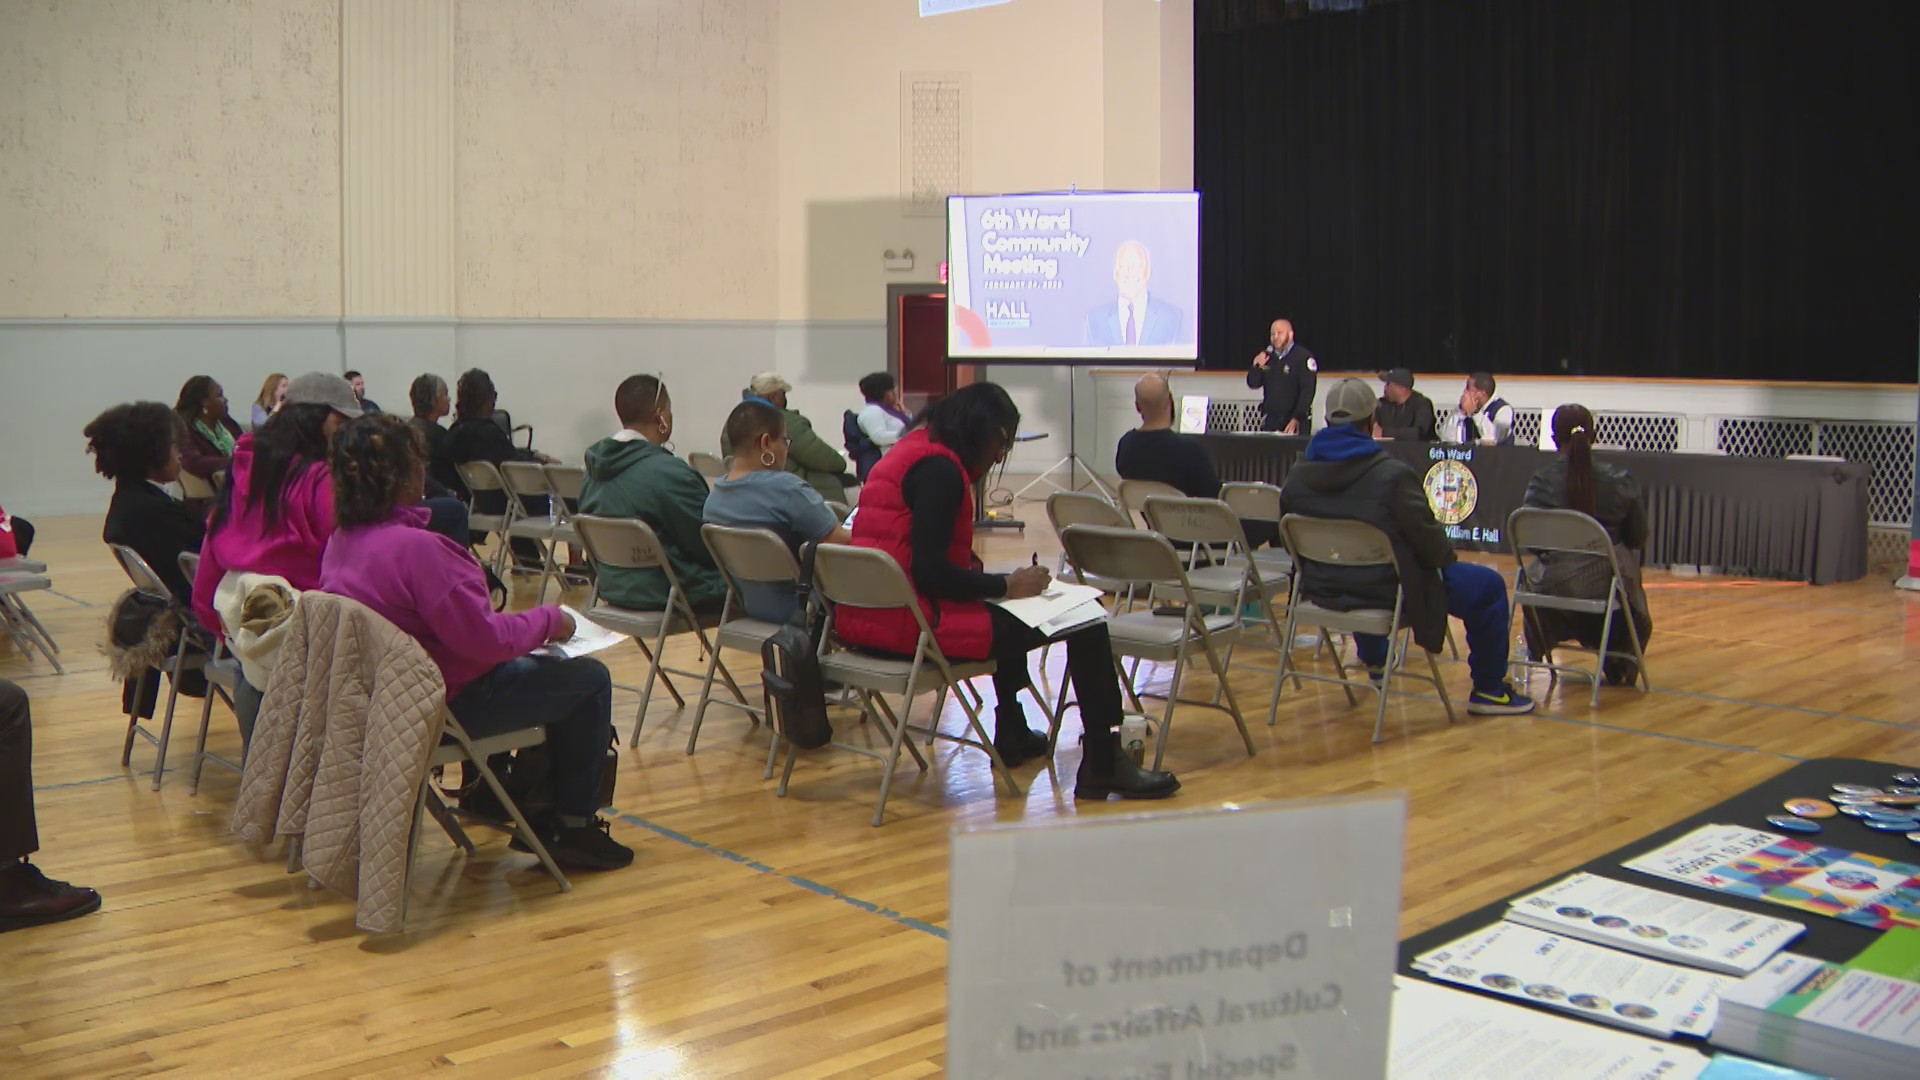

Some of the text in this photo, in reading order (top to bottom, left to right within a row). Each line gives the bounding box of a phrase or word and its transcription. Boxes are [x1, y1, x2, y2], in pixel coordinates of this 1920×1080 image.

[981, 208, 1071, 230] 6th Ward
[982, 231, 1090, 257] Community
[983, 253, 1058, 279] Meeting
[985, 300, 1031, 319] HALL
[1429, 448, 1472, 461] 6th Ward
[1482, 528, 1499, 542] Hall
